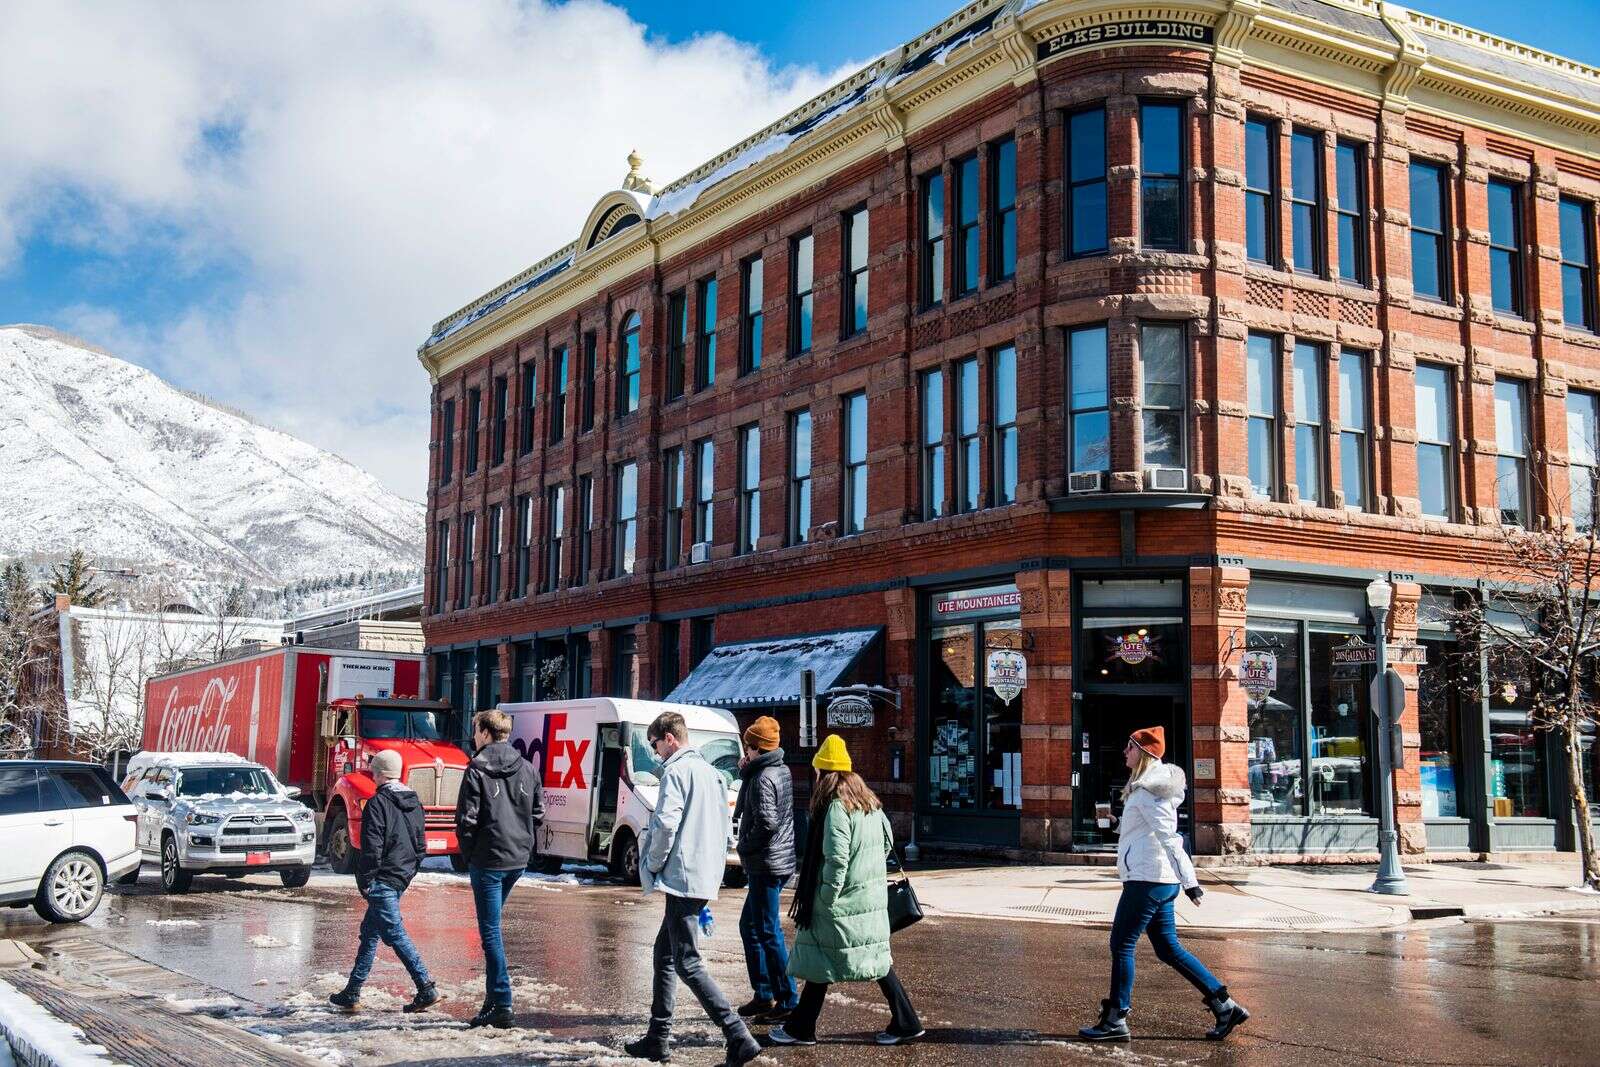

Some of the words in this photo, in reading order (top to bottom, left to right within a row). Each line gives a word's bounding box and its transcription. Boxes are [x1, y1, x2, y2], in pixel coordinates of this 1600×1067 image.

[1049, 27, 1102, 52] ELKS
[1104, 22, 1204, 39] BUILDING
[937, 601, 955, 612] UTE
[1124, 643, 1143, 651] UTE
[1368, 648, 1376, 660] ST
[997, 668, 1016, 677] UTE
[1248, 669, 1267, 679] UTE
[511, 713, 591, 789] dEx
